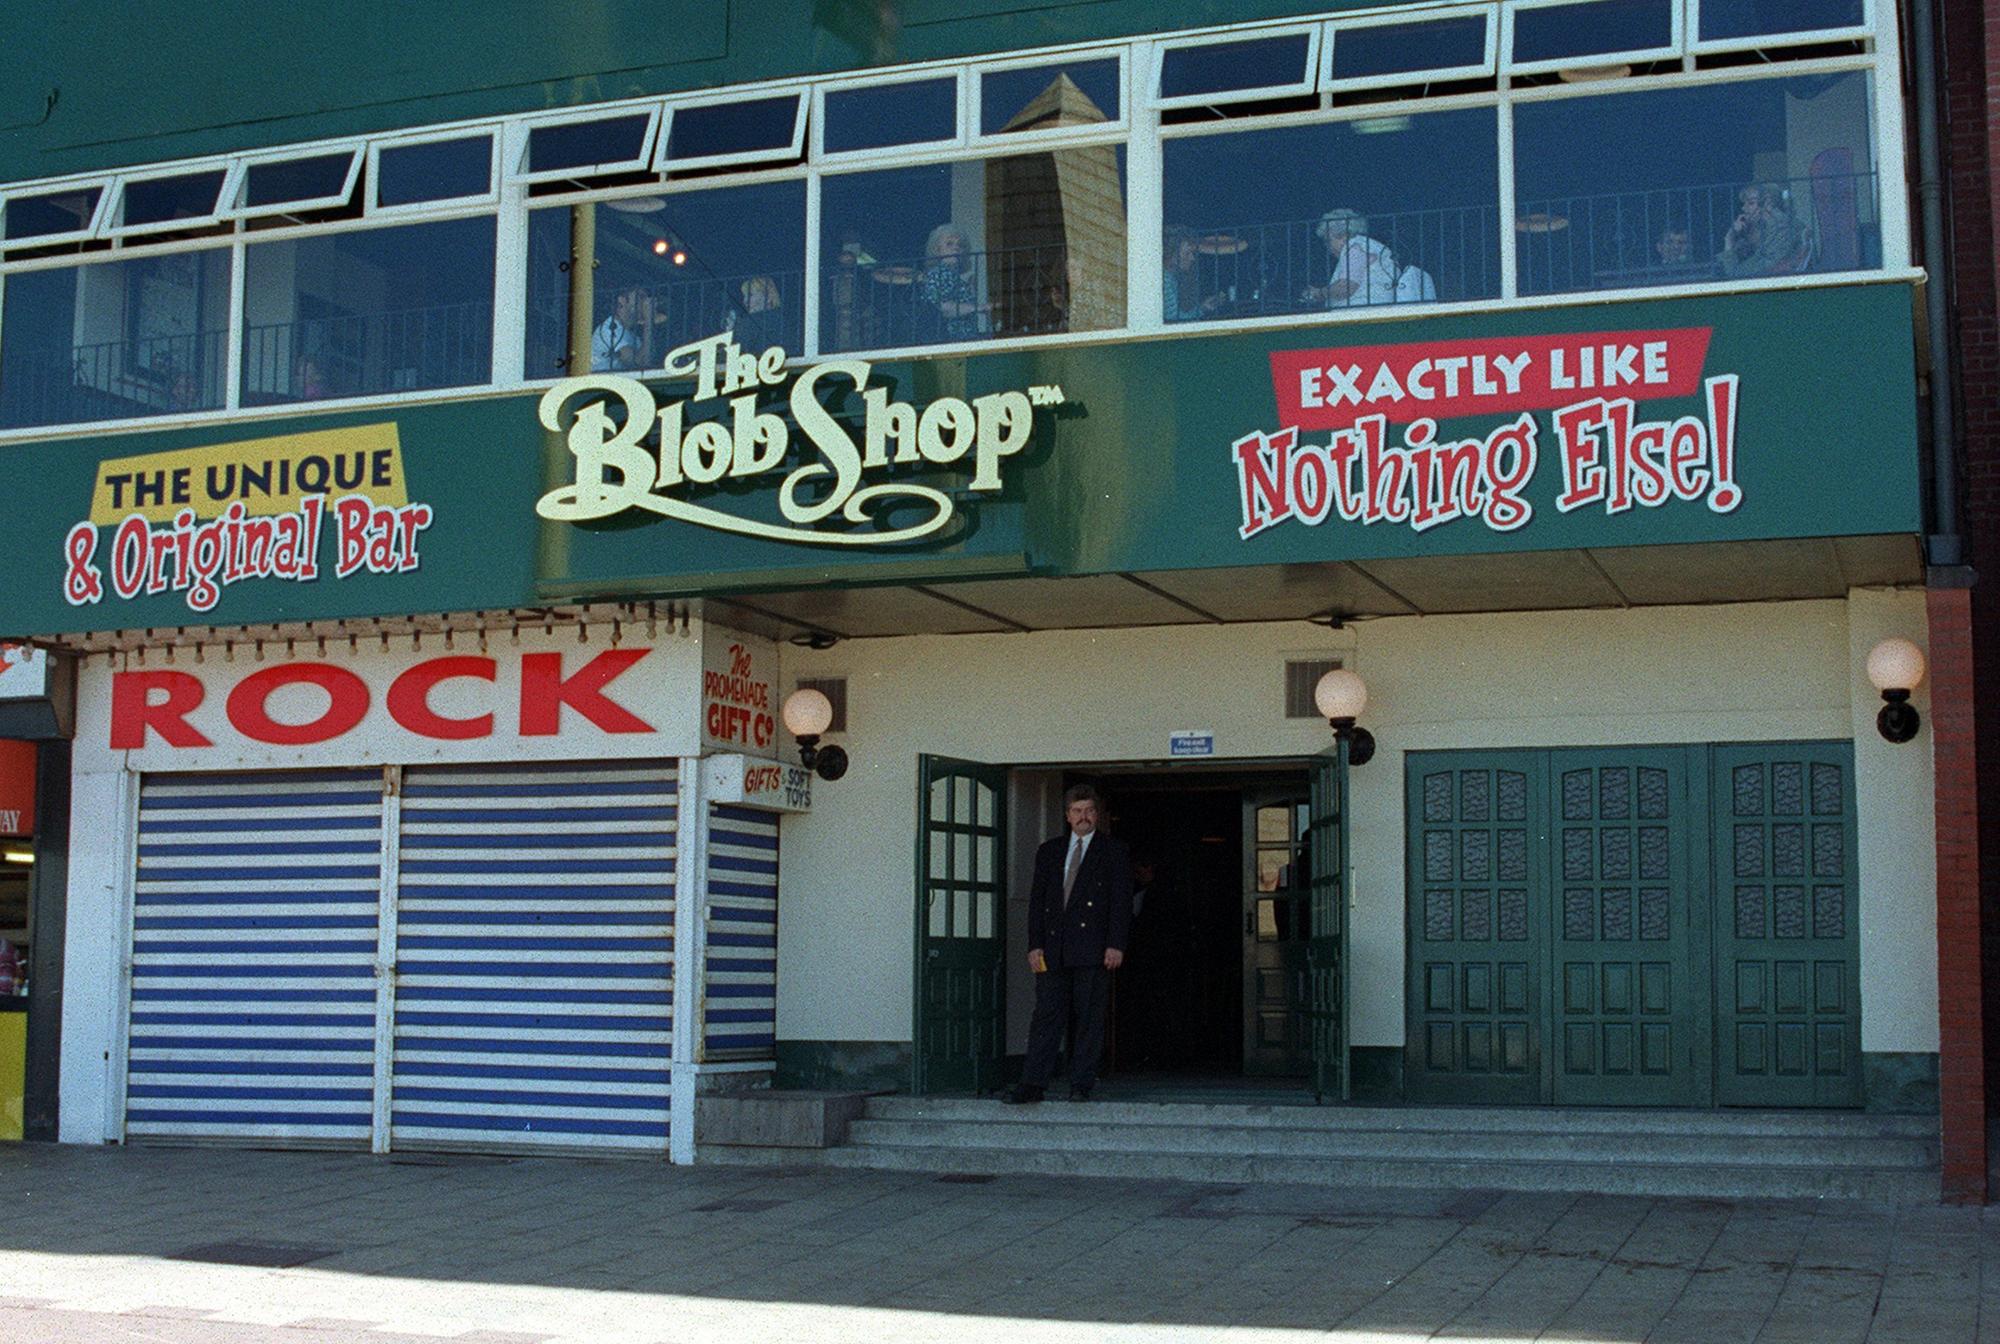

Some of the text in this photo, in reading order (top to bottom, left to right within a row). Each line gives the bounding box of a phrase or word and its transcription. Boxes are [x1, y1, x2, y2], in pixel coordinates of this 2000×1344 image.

[664, 330, 789, 402] The
[1299, 341, 1669, 408] EXACTLY LIKE
[105, 449, 393, 509] THE UNIQUE
[537, 375, 789, 543] Blob
[1232, 373, 1743, 540] Nothing Else!
[63, 492, 433, 611] & Original Bar
[704, 670, 769, 710] PROMENADE
[729, 643, 752, 679] The
[109, 648, 658, 750] ROCK
[707, 703, 751, 744] GIFT
[744, 764, 781, 793] GIFTS
[788, 768, 812, 790] SOFT
[785, 787, 812, 808] TOYS
[0, 810, 21, 833] AY
